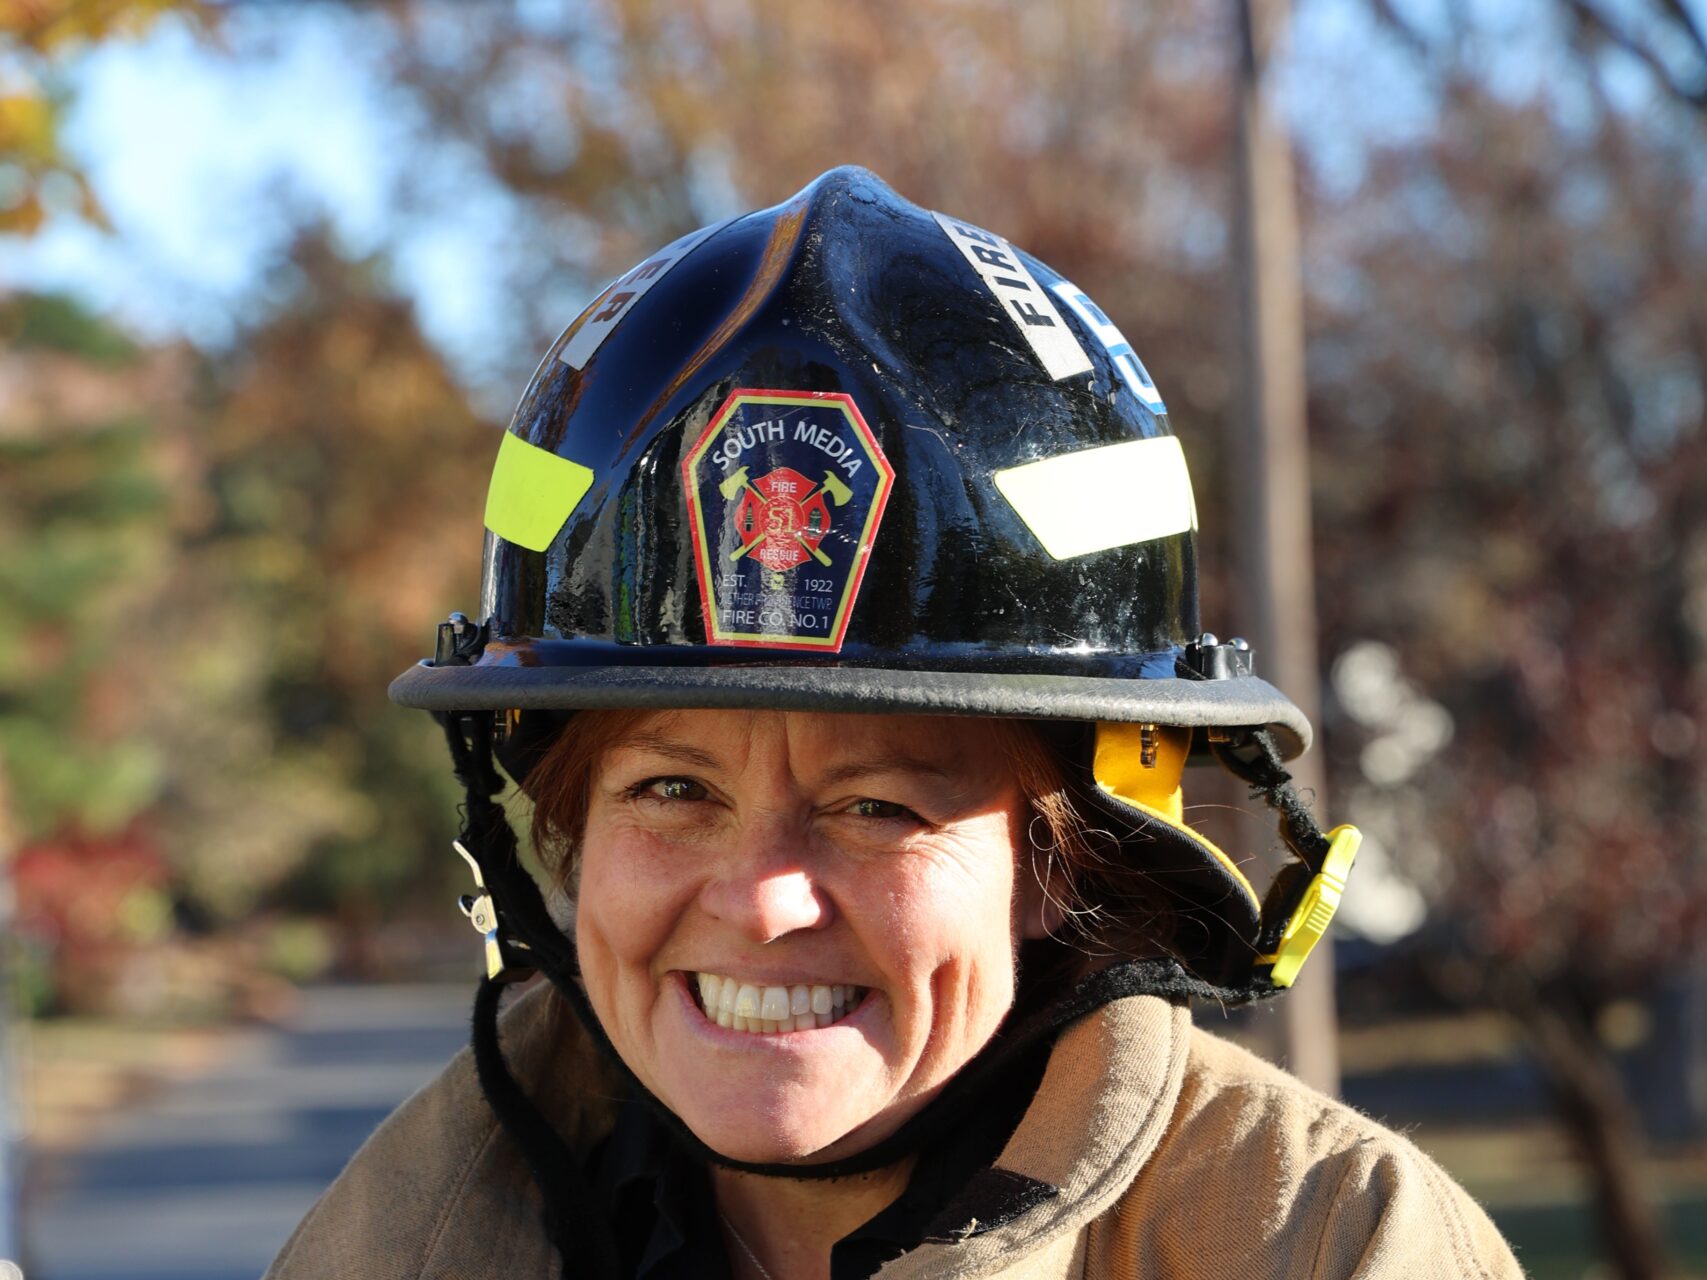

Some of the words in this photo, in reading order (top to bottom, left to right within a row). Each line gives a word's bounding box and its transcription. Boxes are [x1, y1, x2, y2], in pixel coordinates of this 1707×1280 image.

[957, 226, 1056, 328] FIRE
[712, 419, 785, 471] SOUTH
[793, 420, 864, 479] MEDIA
[771, 481, 797, 493] FIRE
[760, 548, 799, 561] RESCUE
[722, 574, 748, 588] EST.
[804, 579, 833, 593] 1922
[722, 609, 756, 625] FIRE
[758, 611, 786, 626] CO.
[790, 613, 819, 629] NO.
[821, 615, 829, 630] 1
